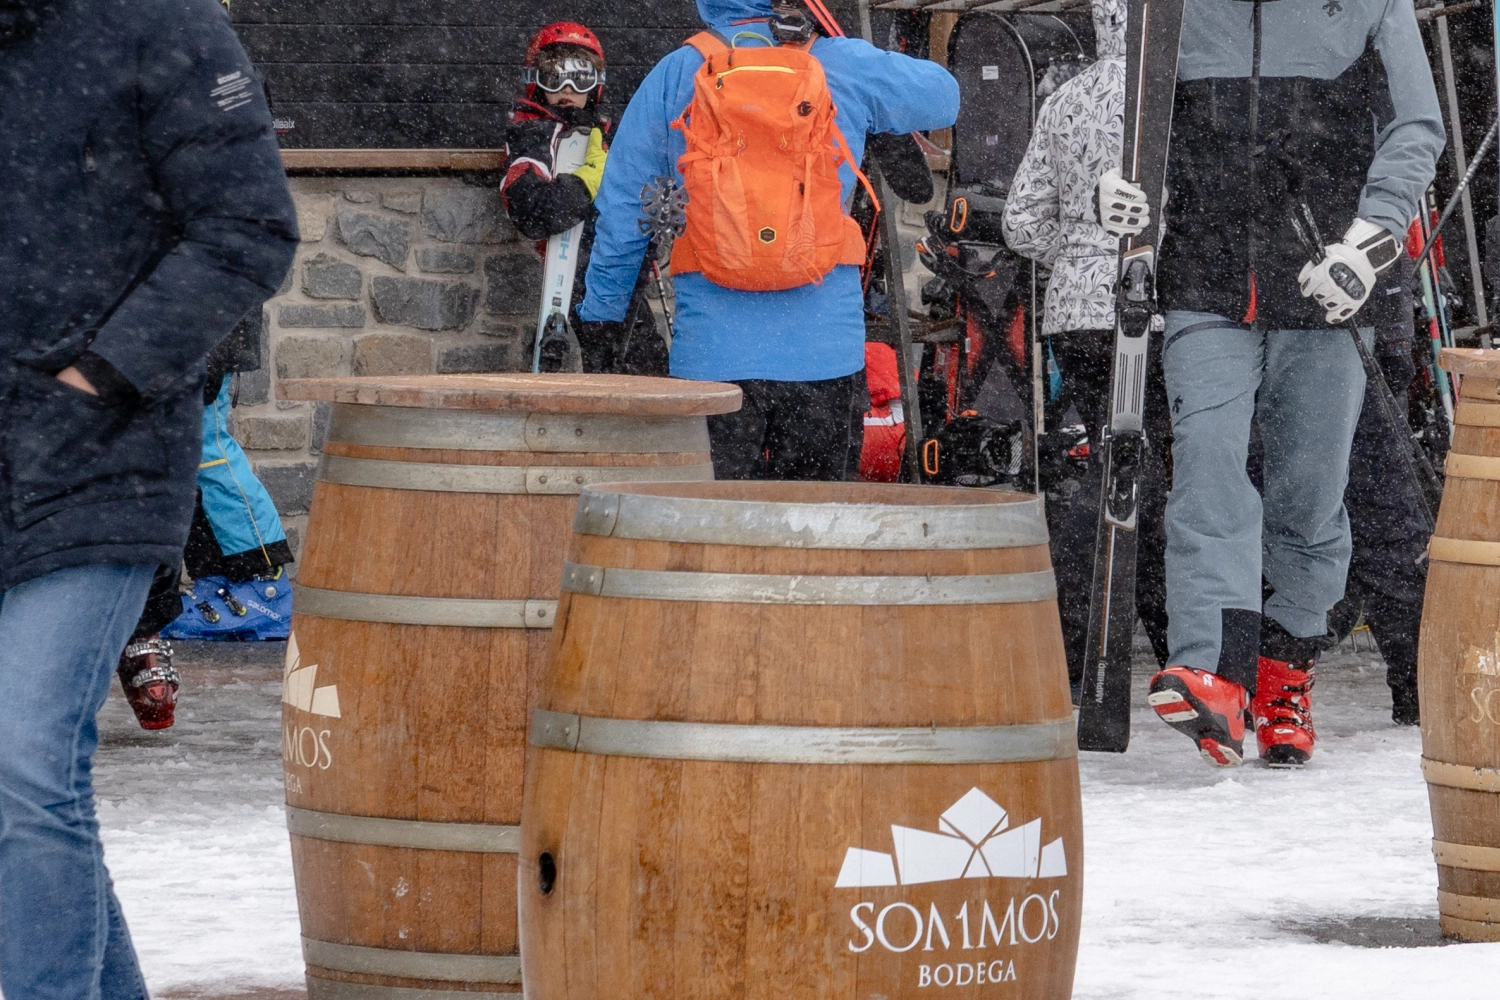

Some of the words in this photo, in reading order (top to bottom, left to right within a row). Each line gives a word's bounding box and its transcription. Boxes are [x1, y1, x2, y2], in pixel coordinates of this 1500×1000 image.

[246, 599, 282, 621] salomon
[848, 889, 1060, 953] SOMMOS
[917, 958, 1017, 988] BODEGA
